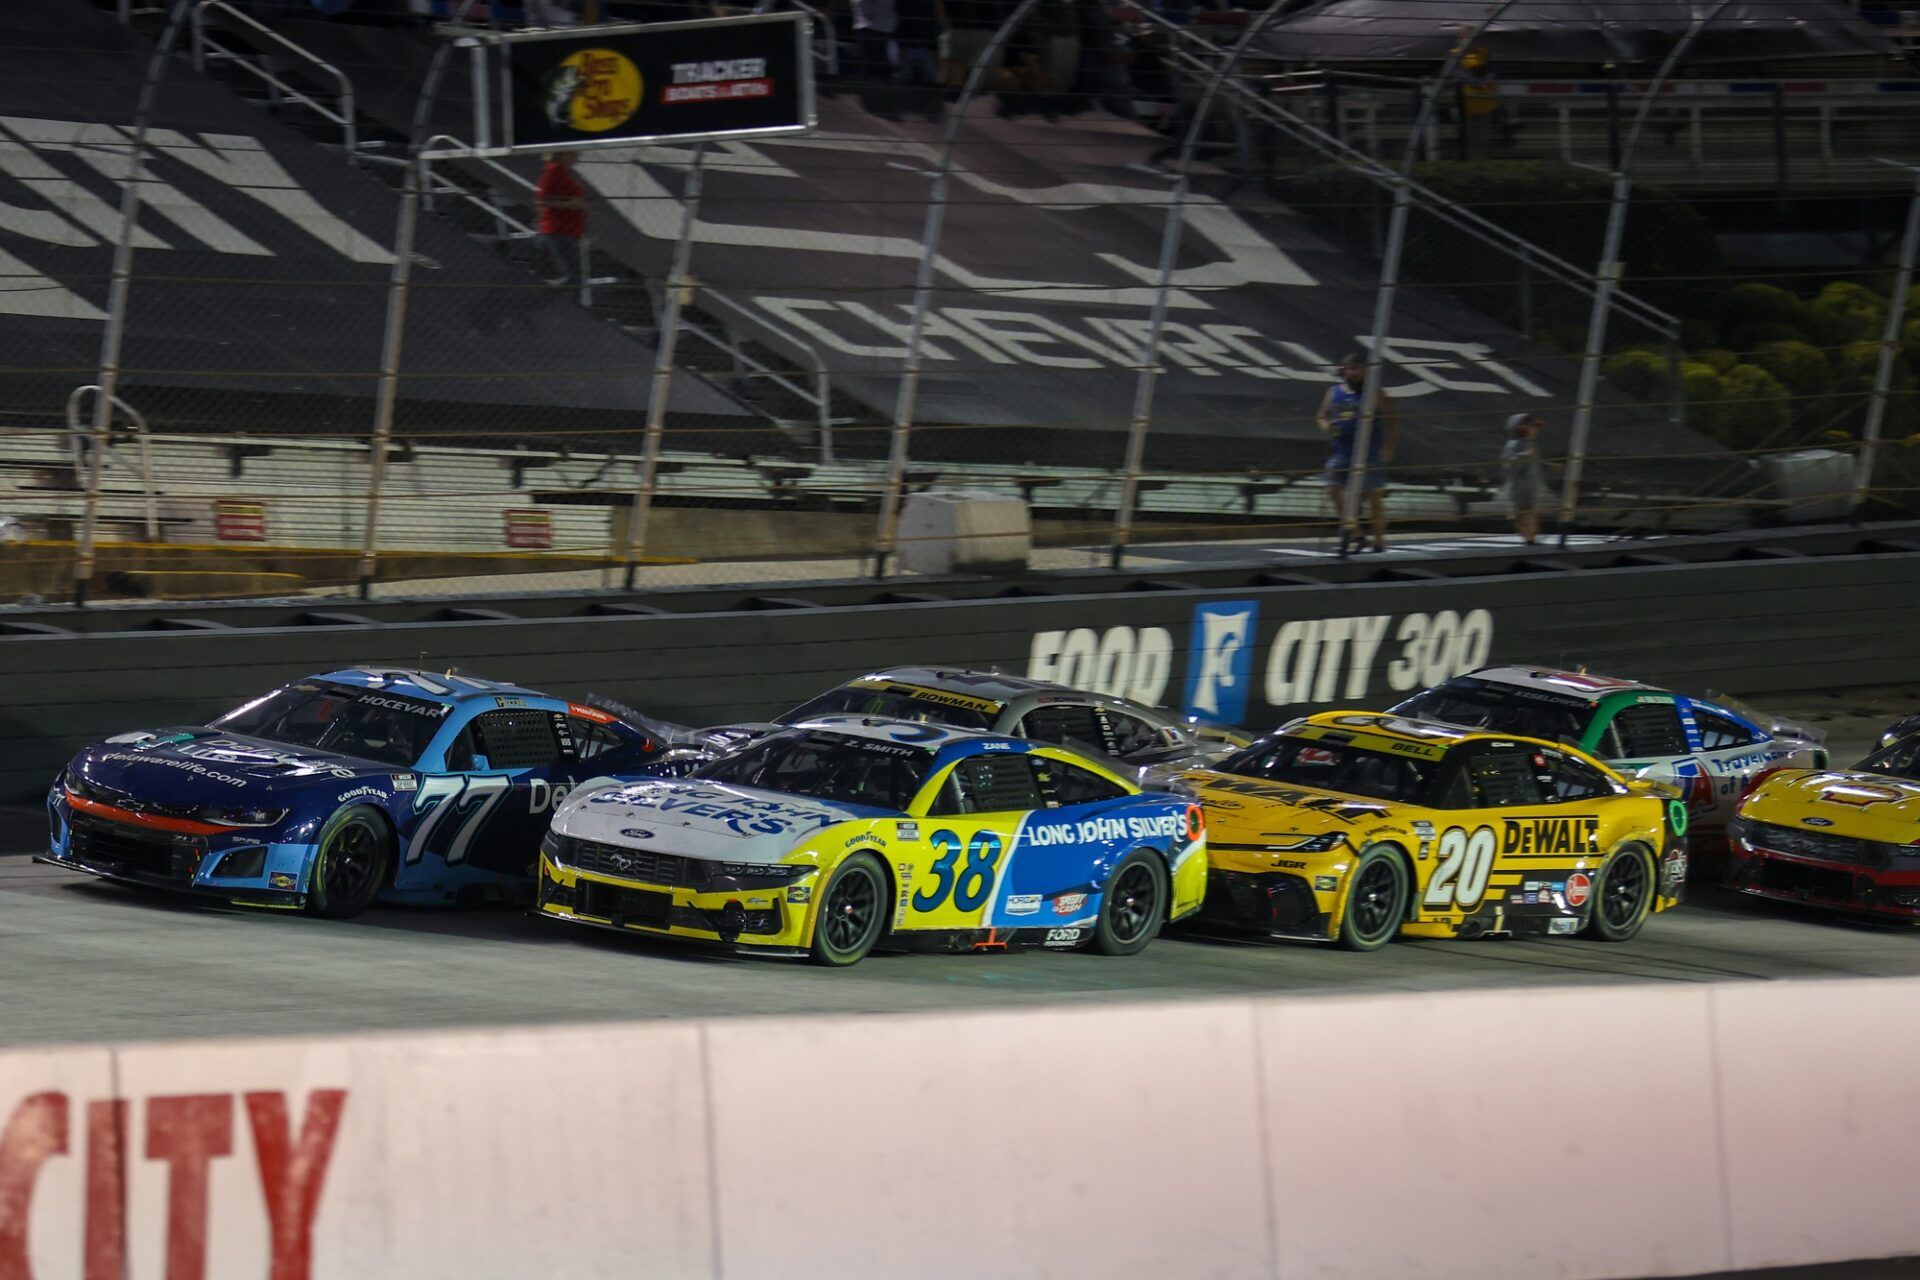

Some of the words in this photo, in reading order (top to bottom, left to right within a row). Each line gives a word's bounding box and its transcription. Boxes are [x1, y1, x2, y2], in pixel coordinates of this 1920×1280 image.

[1026, 626, 1173, 708] FOOD
[1264, 614, 1392, 705] CITY
[1387, 608, 1494, 691] 300
[357, 695, 440, 718] HOCEVAR
[916, 690, 987, 712] BOWMAN
[862, 743, 914, 756] SMITH
[981, 742, 1011, 750] ZANE
[1391, 743, 1432, 756] BELL
[102, 752, 248, 788] delawarelife.com
[337, 785, 387, 802] GOODYEAR
[405, 774, 514, 868] 77
[1026, 823, 1075, 847] LONG
[1074, 818, 1129, 845] JOHN
[1126, 810, 1188, 843] SILVER'S
[845, 831, 887, 848] GOODYEAR
[911, 828, 1002, 914] 38
[1271, 860, 1307, 869] JGR
[1422, 825, 1496, 913] 20
[1045, 928, 1080, 941] FORD
[0, 1089, 349, 1280] CITY
